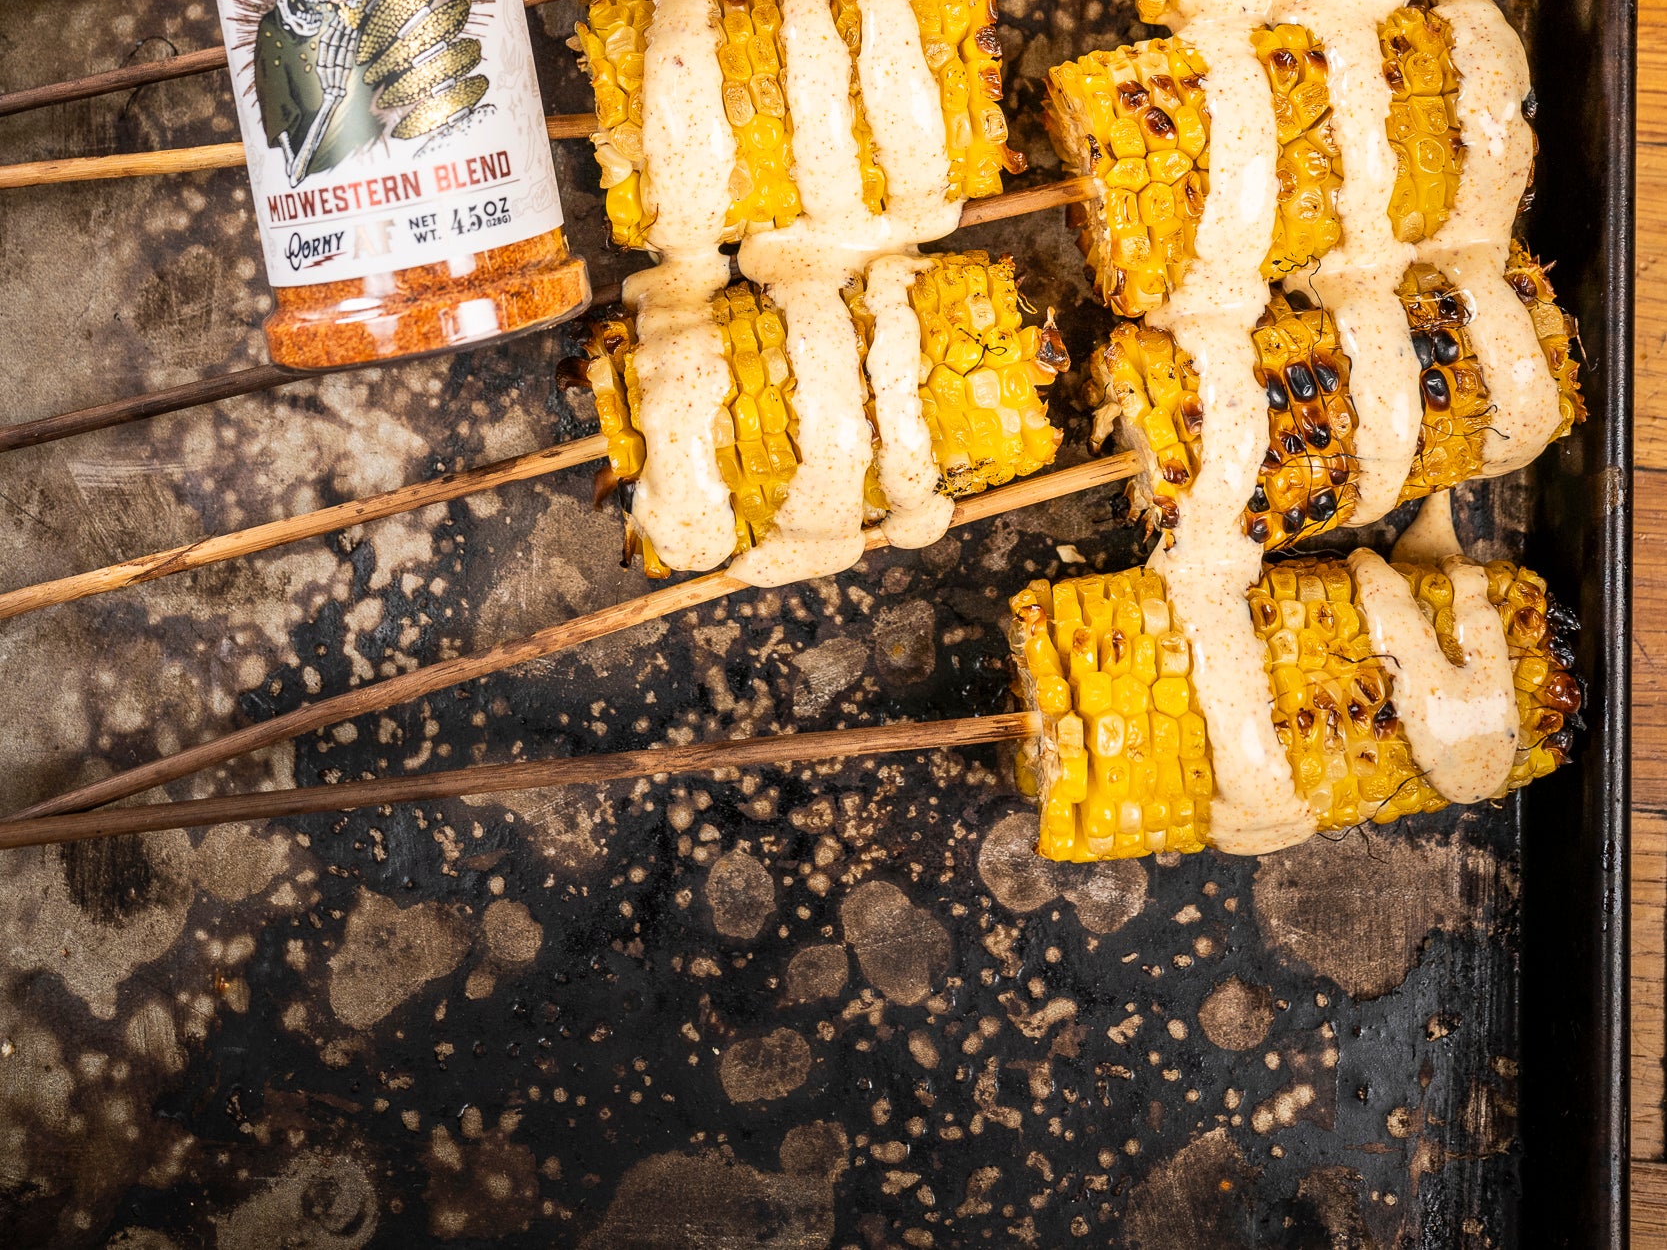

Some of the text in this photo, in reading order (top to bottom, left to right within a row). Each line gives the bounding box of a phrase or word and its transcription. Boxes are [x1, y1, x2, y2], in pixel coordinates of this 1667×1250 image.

[266, 150, 512, 223] MIDWESTERN BLEND
[408, 213, 438, 230] NET
[353, 218, 396, 260] AF
[414, 229, 442, 245] WT.
